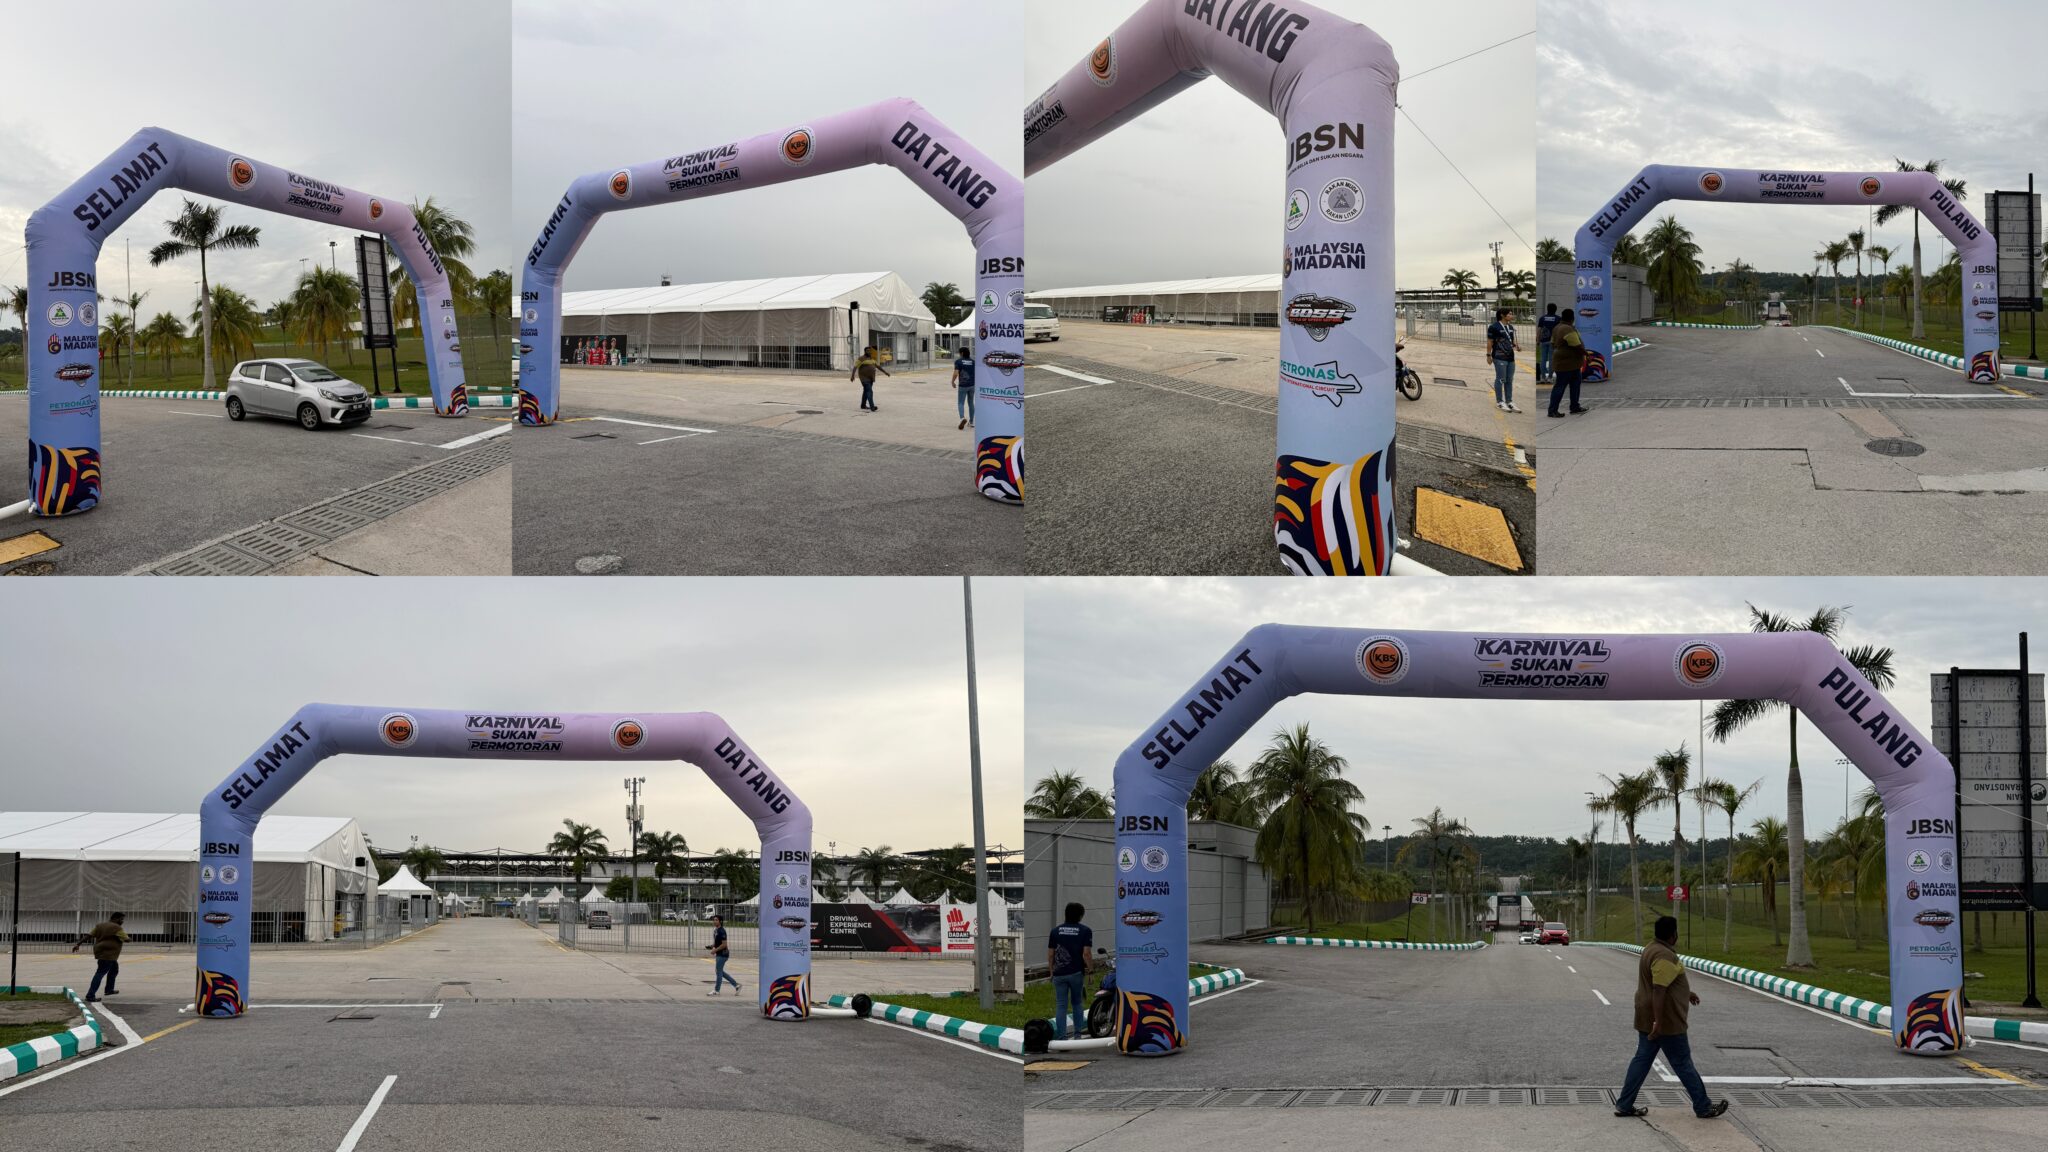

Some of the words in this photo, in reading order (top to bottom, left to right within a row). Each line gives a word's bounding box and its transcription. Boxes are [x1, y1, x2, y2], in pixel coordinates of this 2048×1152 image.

[1024, 103, 1065, 141] ERMOTORAN
[791, 139, 807, 150] KBS
[1287, 122, 1364, 171] JBSN
[664, 143, 738, 171] KARNIVAL
[1309, 156, 1320, 165] DAN
[1320, 153, 1340, 161] SUKAN
[681, 162, 716, 177] SUKAN
[891, 121, 997, 209] DATANG
[288, 173, 344, 196] KARNIVAL
[669, 169, 739, 191] PERMOTORAN
[1760, 173, 1824, 183] KARNIVAL
[73, 142, 168, 231] SELAMAT
[1325, 181, 1344, 195] RAKAN
[1761, 190, 1824, 198] PERMOTORAN
[304, 188, 331, 202] SUKAN
[288, 195, 343, 214] PERMOTORAN
[1588, 177, 1651, 237] SELAMAT
[1325, 208, 1343, 219] RAKAN
[1344, 208, 1358, 219] LITAR
[1929, 189, 1981, 240] PULANG
[528, 192, 573, 266] SELAMAT
[1294, 242, 1365, 257] MALAYSIA
[1294, 254, 1366, 271] MADANI
[1577, 260, 1603, 269] JBSN
[48, 271, 95, 288] JBSN
[1291, 308, 1346, 318] BOSS
[980, 387, 1018, 396] PETRONAS
[1477, 640, 1608, 656] KARNIVAL
[1375, 654, 1396, 662] KBS
[1510, 658, 1574, 671] SUKAN
[1692, 658, 1713, 667] KBS
[1482, 673, 1606, 687] PERMOTORAN
[1141, 648, 1262, 770] SELAMAT
[467, 716, 563, 730] KARNIVAL
[1818, 666, 1922, 769] PULANG
[491, 730, 537, 740] SUKAN
[470, 741, 562, 751] PERMOTORAN
[221, 721, 310, 809] SELAMAT
[714, 737, 791, 814] DATANG
[1974, 783, 2023, 791] RANDSTAND
[1118, 815, 1169, 832] JBSN
[1906, 818, 1954, 835] JBSN
[202, 842, 240, 855] JBSN
[775, 851, 810, 862] JBSN
[1127, 887, 1170, 896] MADANI
